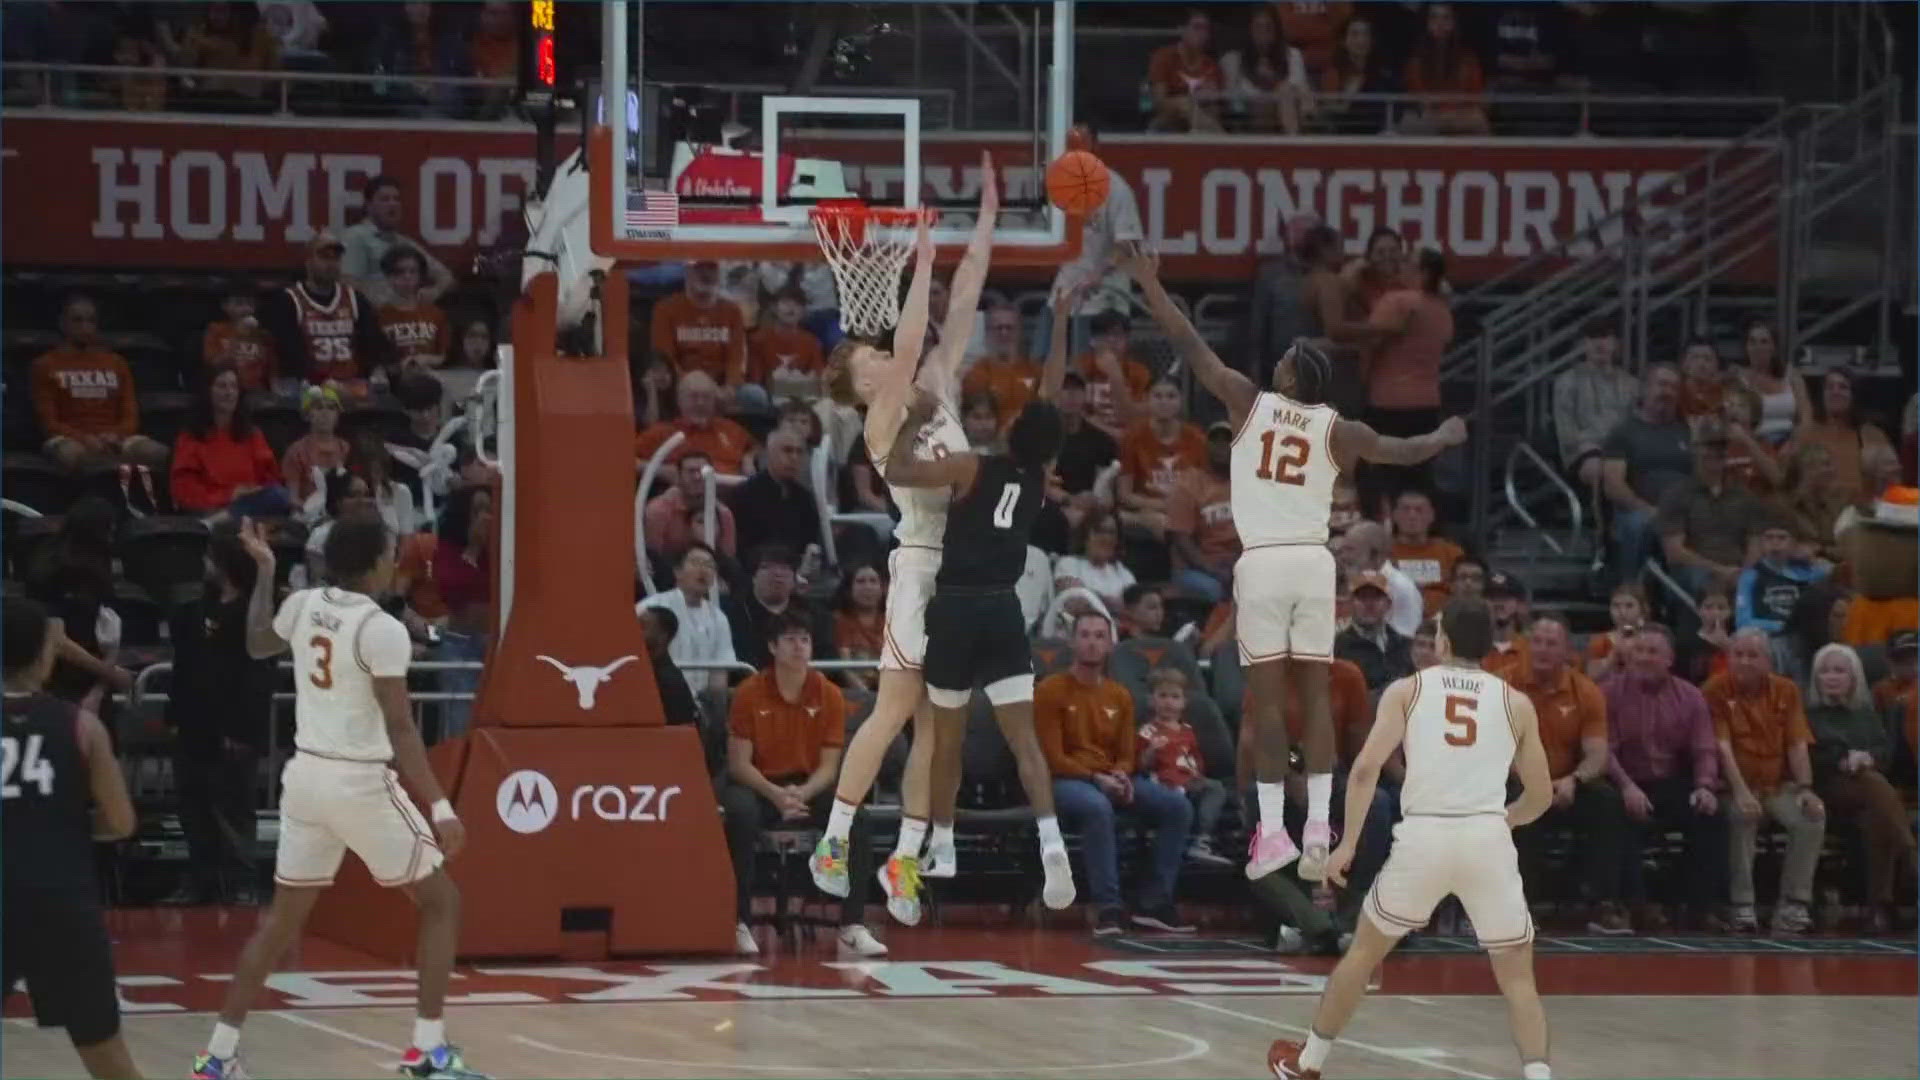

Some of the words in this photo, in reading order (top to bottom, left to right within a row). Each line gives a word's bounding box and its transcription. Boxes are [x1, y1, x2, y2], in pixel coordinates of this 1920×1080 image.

[91, 147, 382, 242] HOME
[419, 157, 538, 246] OF
[312, 337, 352, 362] 35
[1272, 408, 1311, 432] MARK
[1256, 429, 1311, 486] 12
[994, 482, 1021, 529] 0
[309, 635, 333, 690] 3
[1444, 694, 1479, 747] 5
[0, 734, 54, 798] 24
[571, 784, 682, 822] razr
